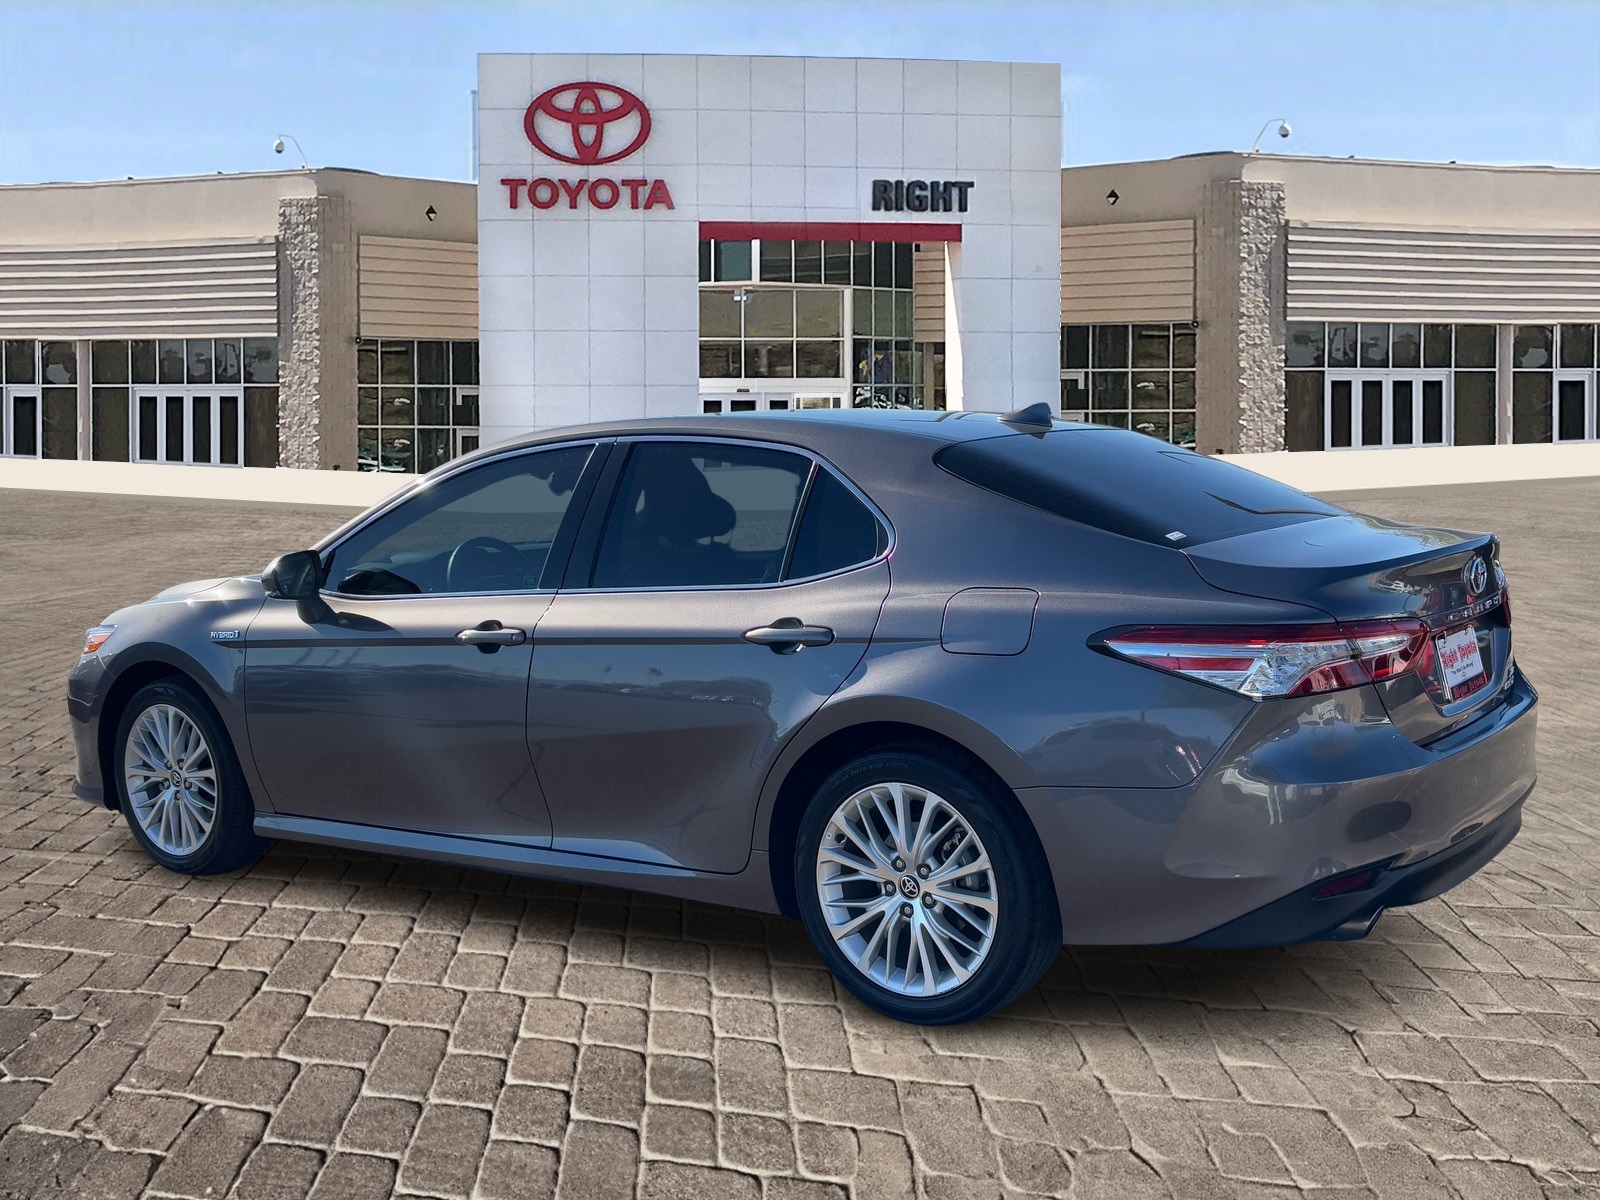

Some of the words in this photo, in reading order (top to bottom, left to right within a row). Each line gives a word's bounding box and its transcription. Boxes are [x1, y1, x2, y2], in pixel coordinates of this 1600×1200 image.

[501, 177, 675, 210] TOYOTA
[872, 180, 974, 212] RIGHT
[210, 631, 235, 639] HYBRID
[1440, 649, 1458, 670] Right
[1457, 641, 1478, 663] Toyota
